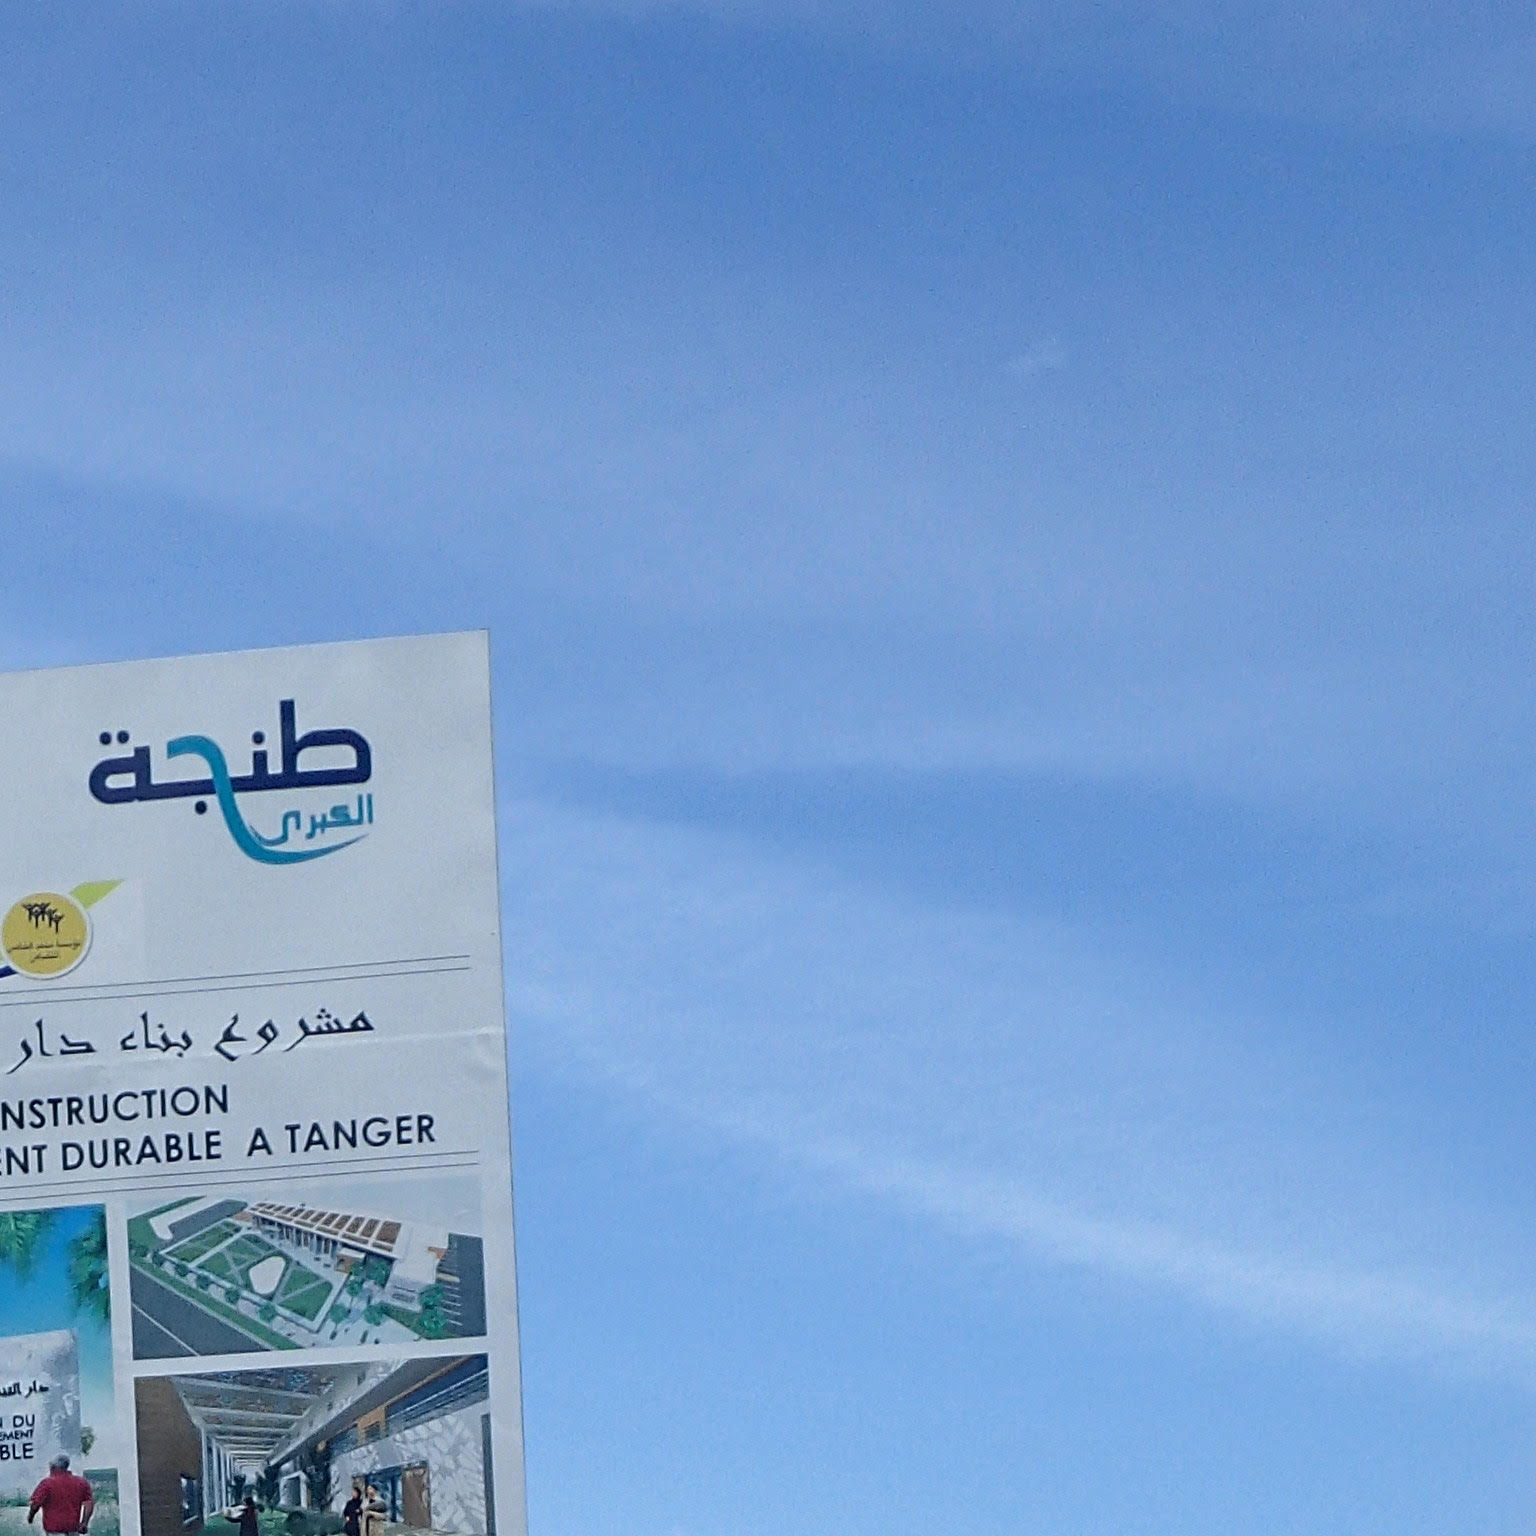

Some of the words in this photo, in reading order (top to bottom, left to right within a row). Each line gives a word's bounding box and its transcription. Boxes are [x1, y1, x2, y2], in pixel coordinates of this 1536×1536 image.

[89, 699, 371, 850] طنجة
[5, 1018, 97, 1075] دار
[119, 1010, 192, 1058] بناء
[212, 1008, 375, 1063] مشروع
[61, 1130, 222, 1171] DURABLE
[246, 1127, 273, 1157] A
[284, 1114, 436, 1154] TANGER
[13, 1414, 35, 1428] DU
